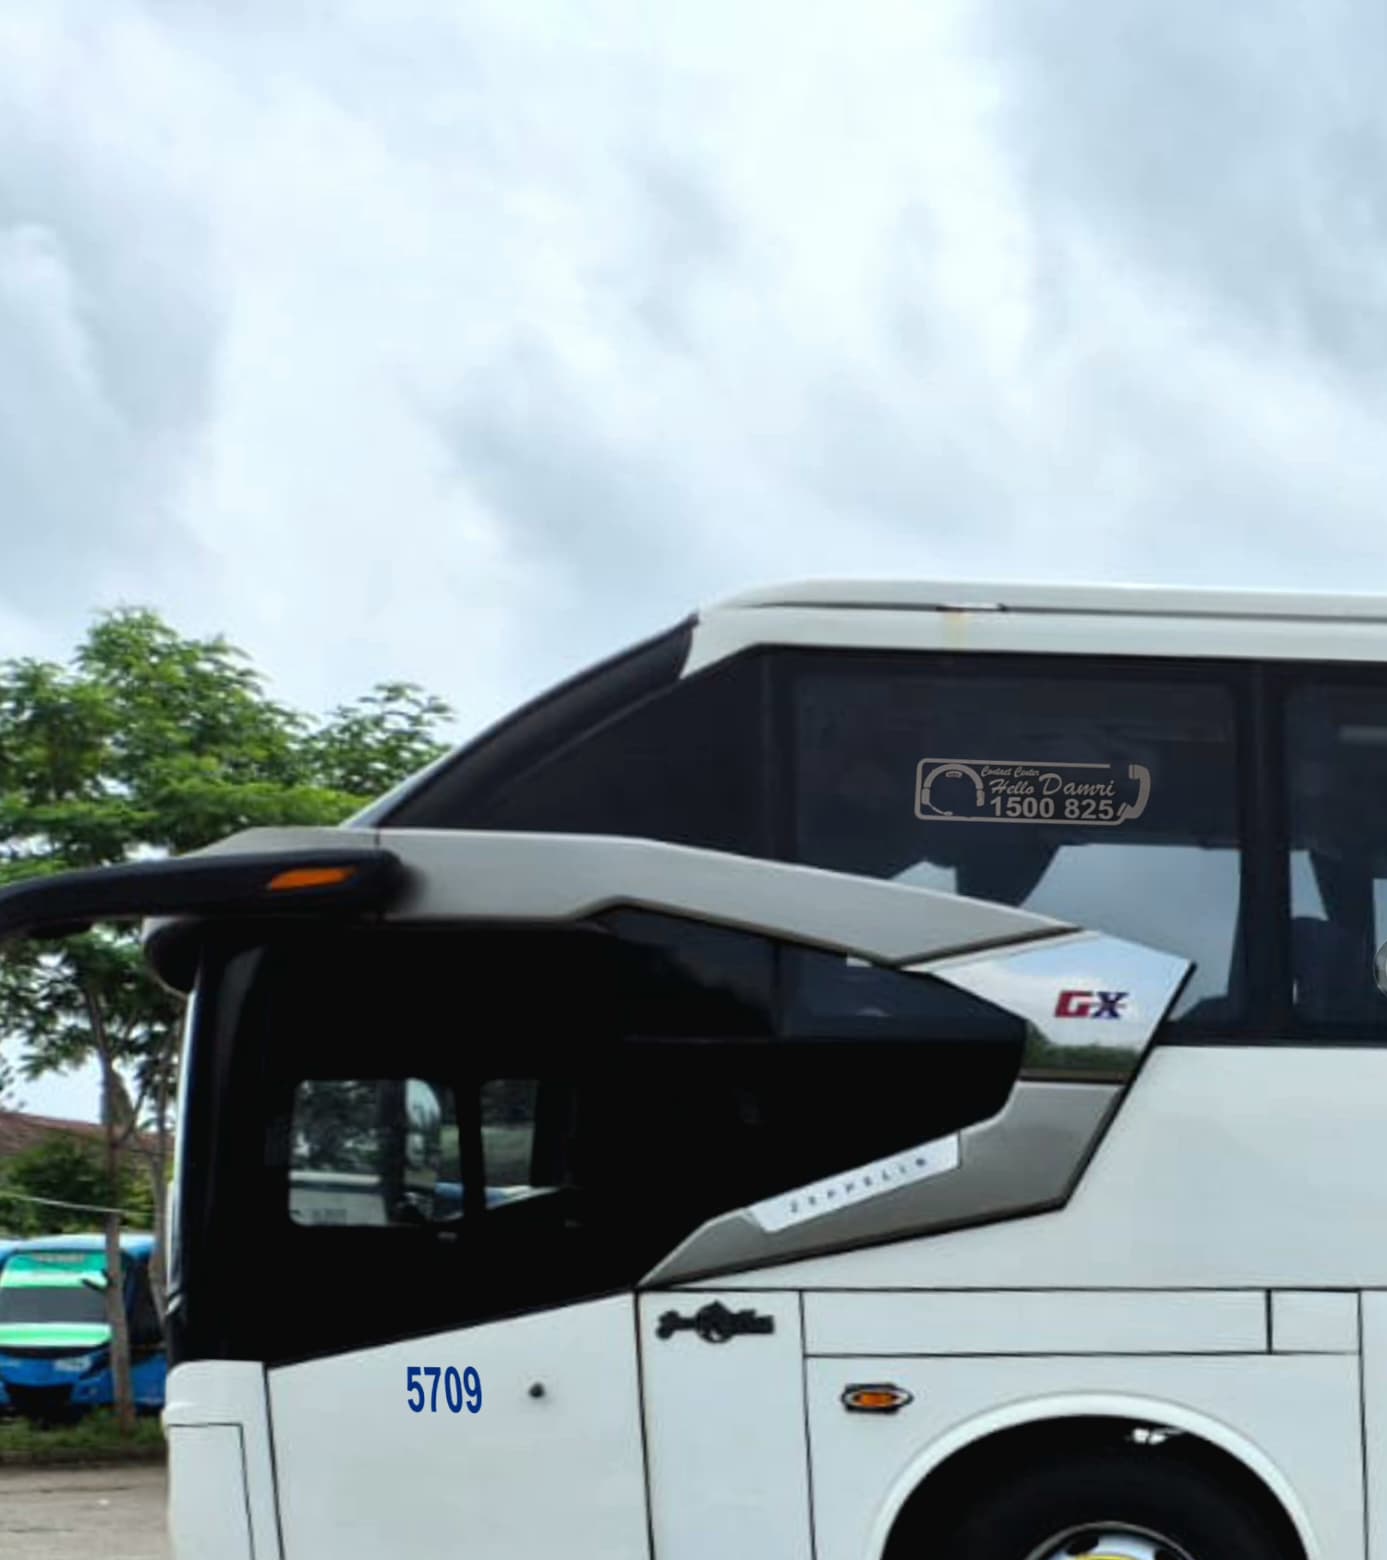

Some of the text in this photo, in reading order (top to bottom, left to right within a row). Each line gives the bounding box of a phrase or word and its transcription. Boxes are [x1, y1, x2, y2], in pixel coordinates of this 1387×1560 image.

[988, 772, 1117, 797] Hello Damri
[990, 796, 1114, 820] 1500 825
[1054, 989, 1130, 1019] GX
[406, 1365, 483, 1414] 5709
